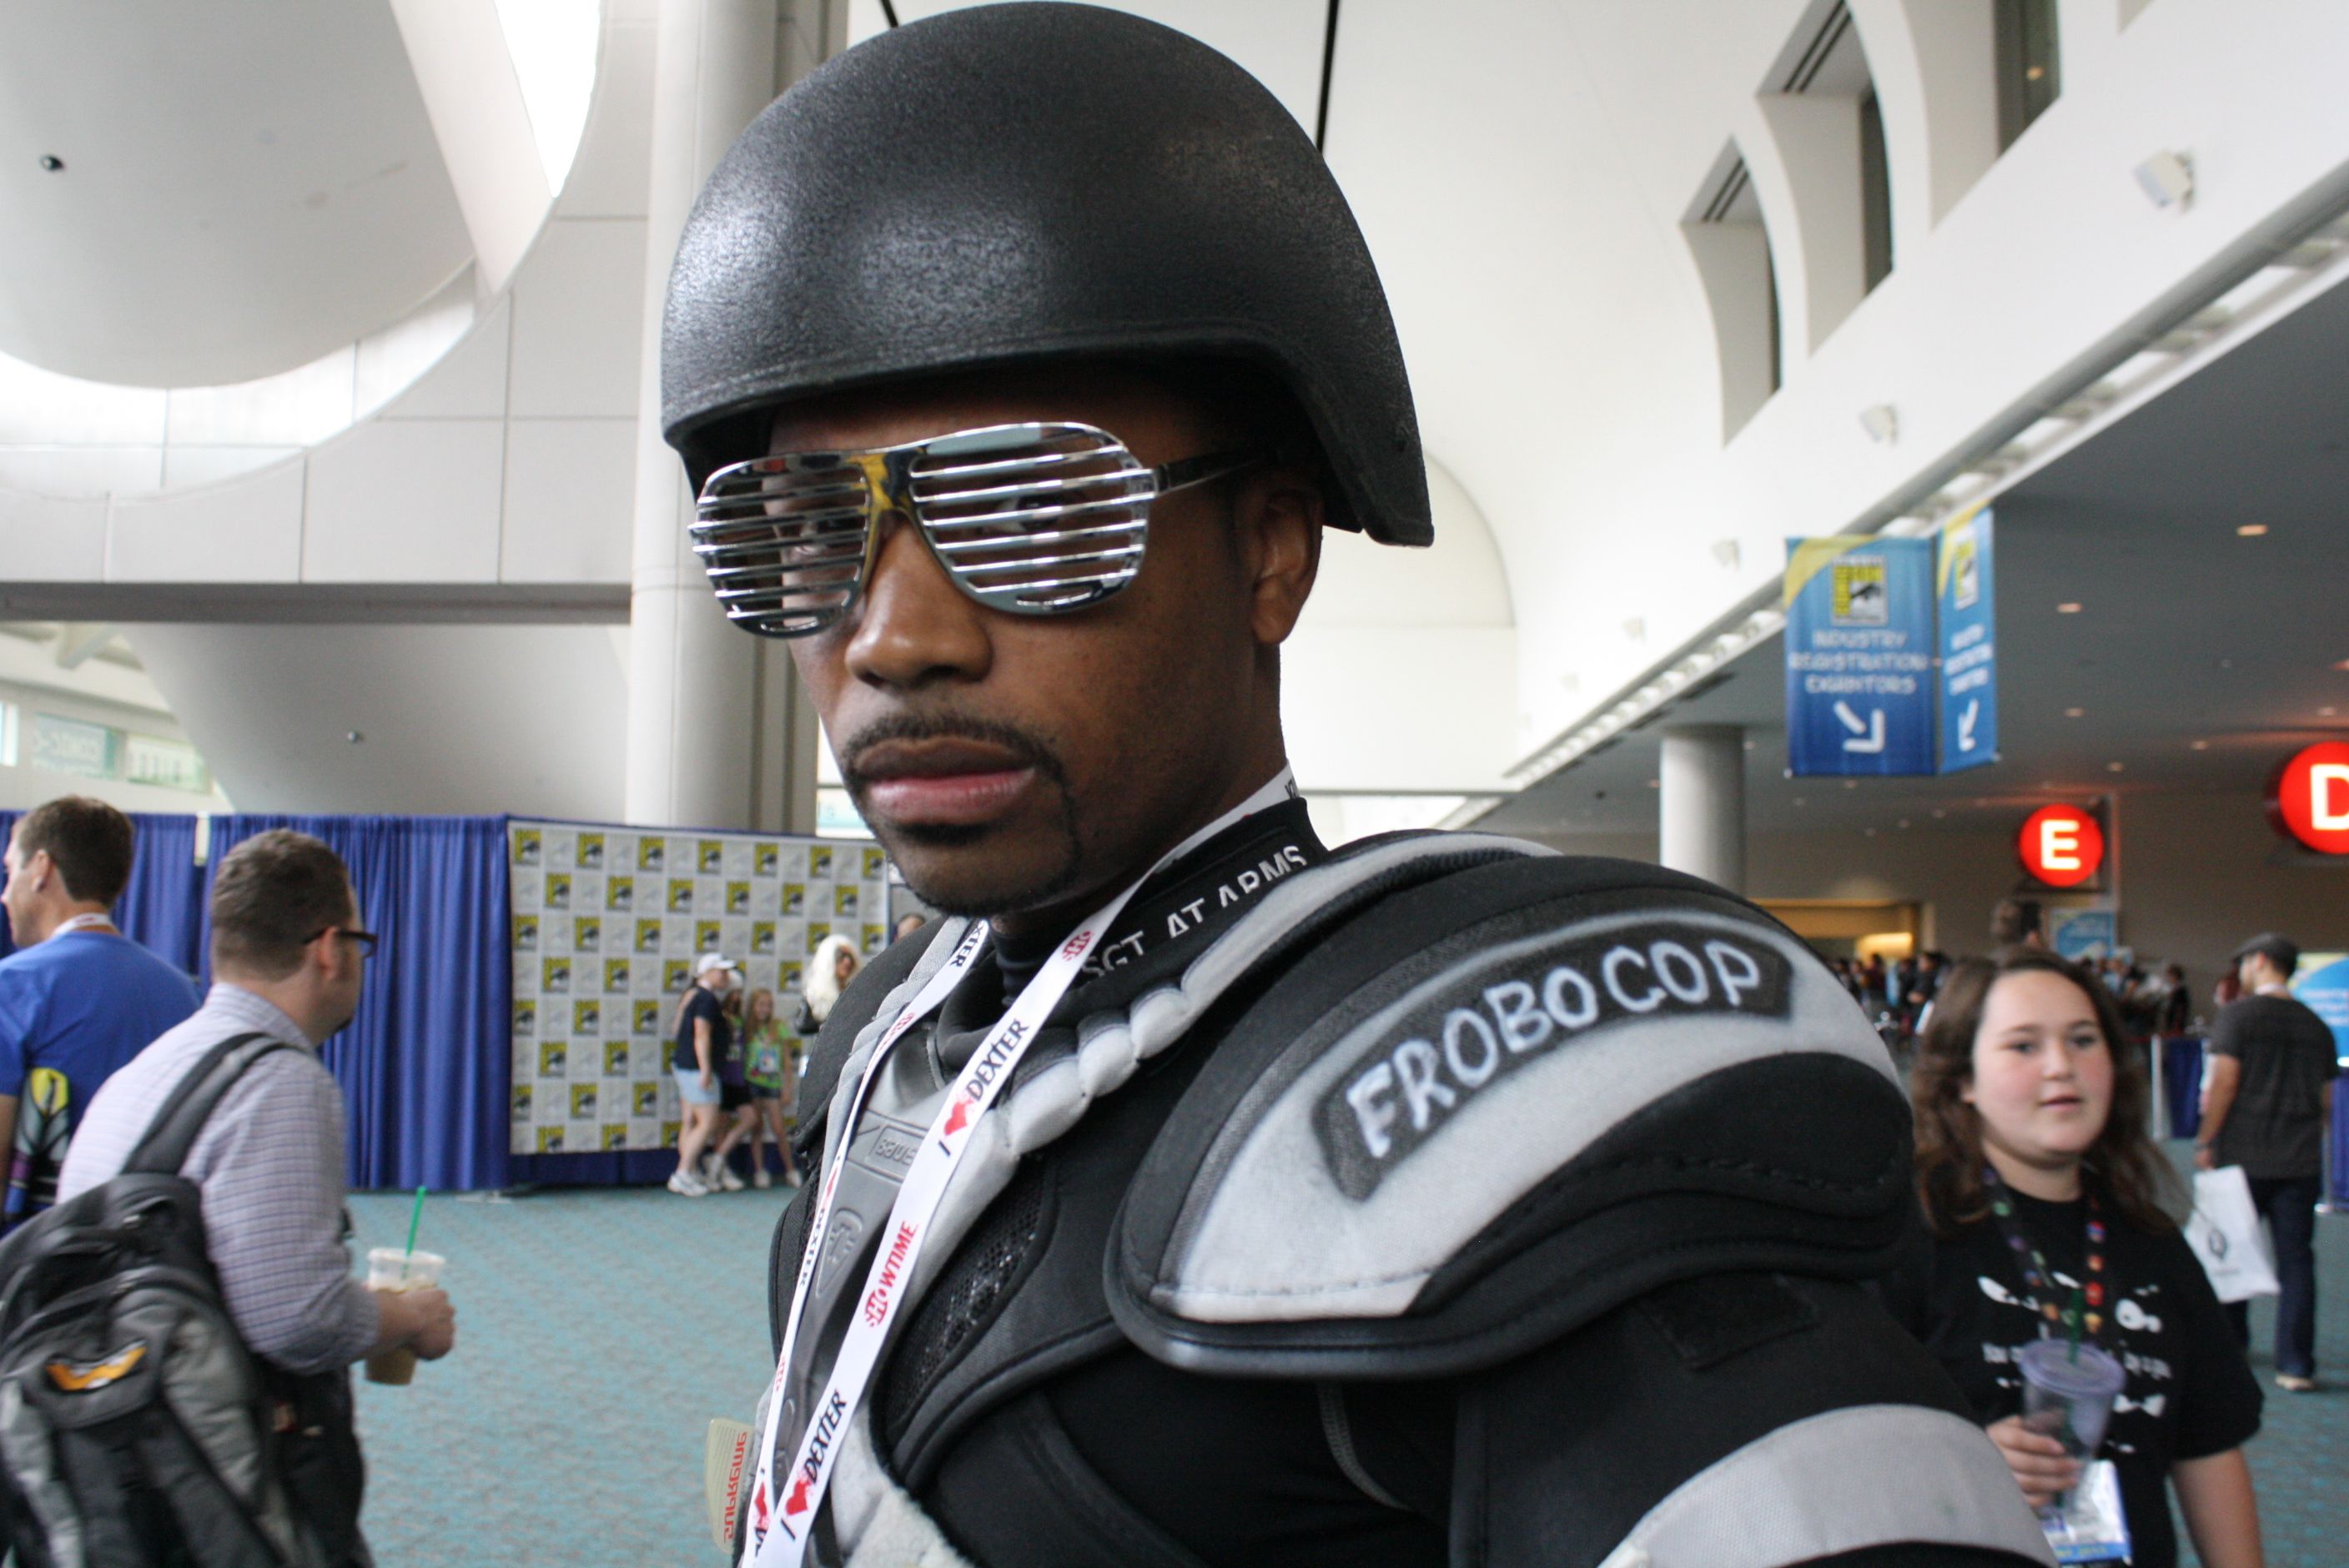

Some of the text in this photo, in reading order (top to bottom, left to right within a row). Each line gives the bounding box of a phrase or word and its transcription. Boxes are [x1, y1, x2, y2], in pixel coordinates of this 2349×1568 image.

[2310, 763, 2349, 830] D
[2040, 819, 2081, 870] E
[1167, 898, 1205, 939] AT
[938, 1018, 1029, 1158] I DEXTER
[865, 1220, 919, 1328] SHOWTIME
[781, 1388, 848, 1542] I DEXTER
